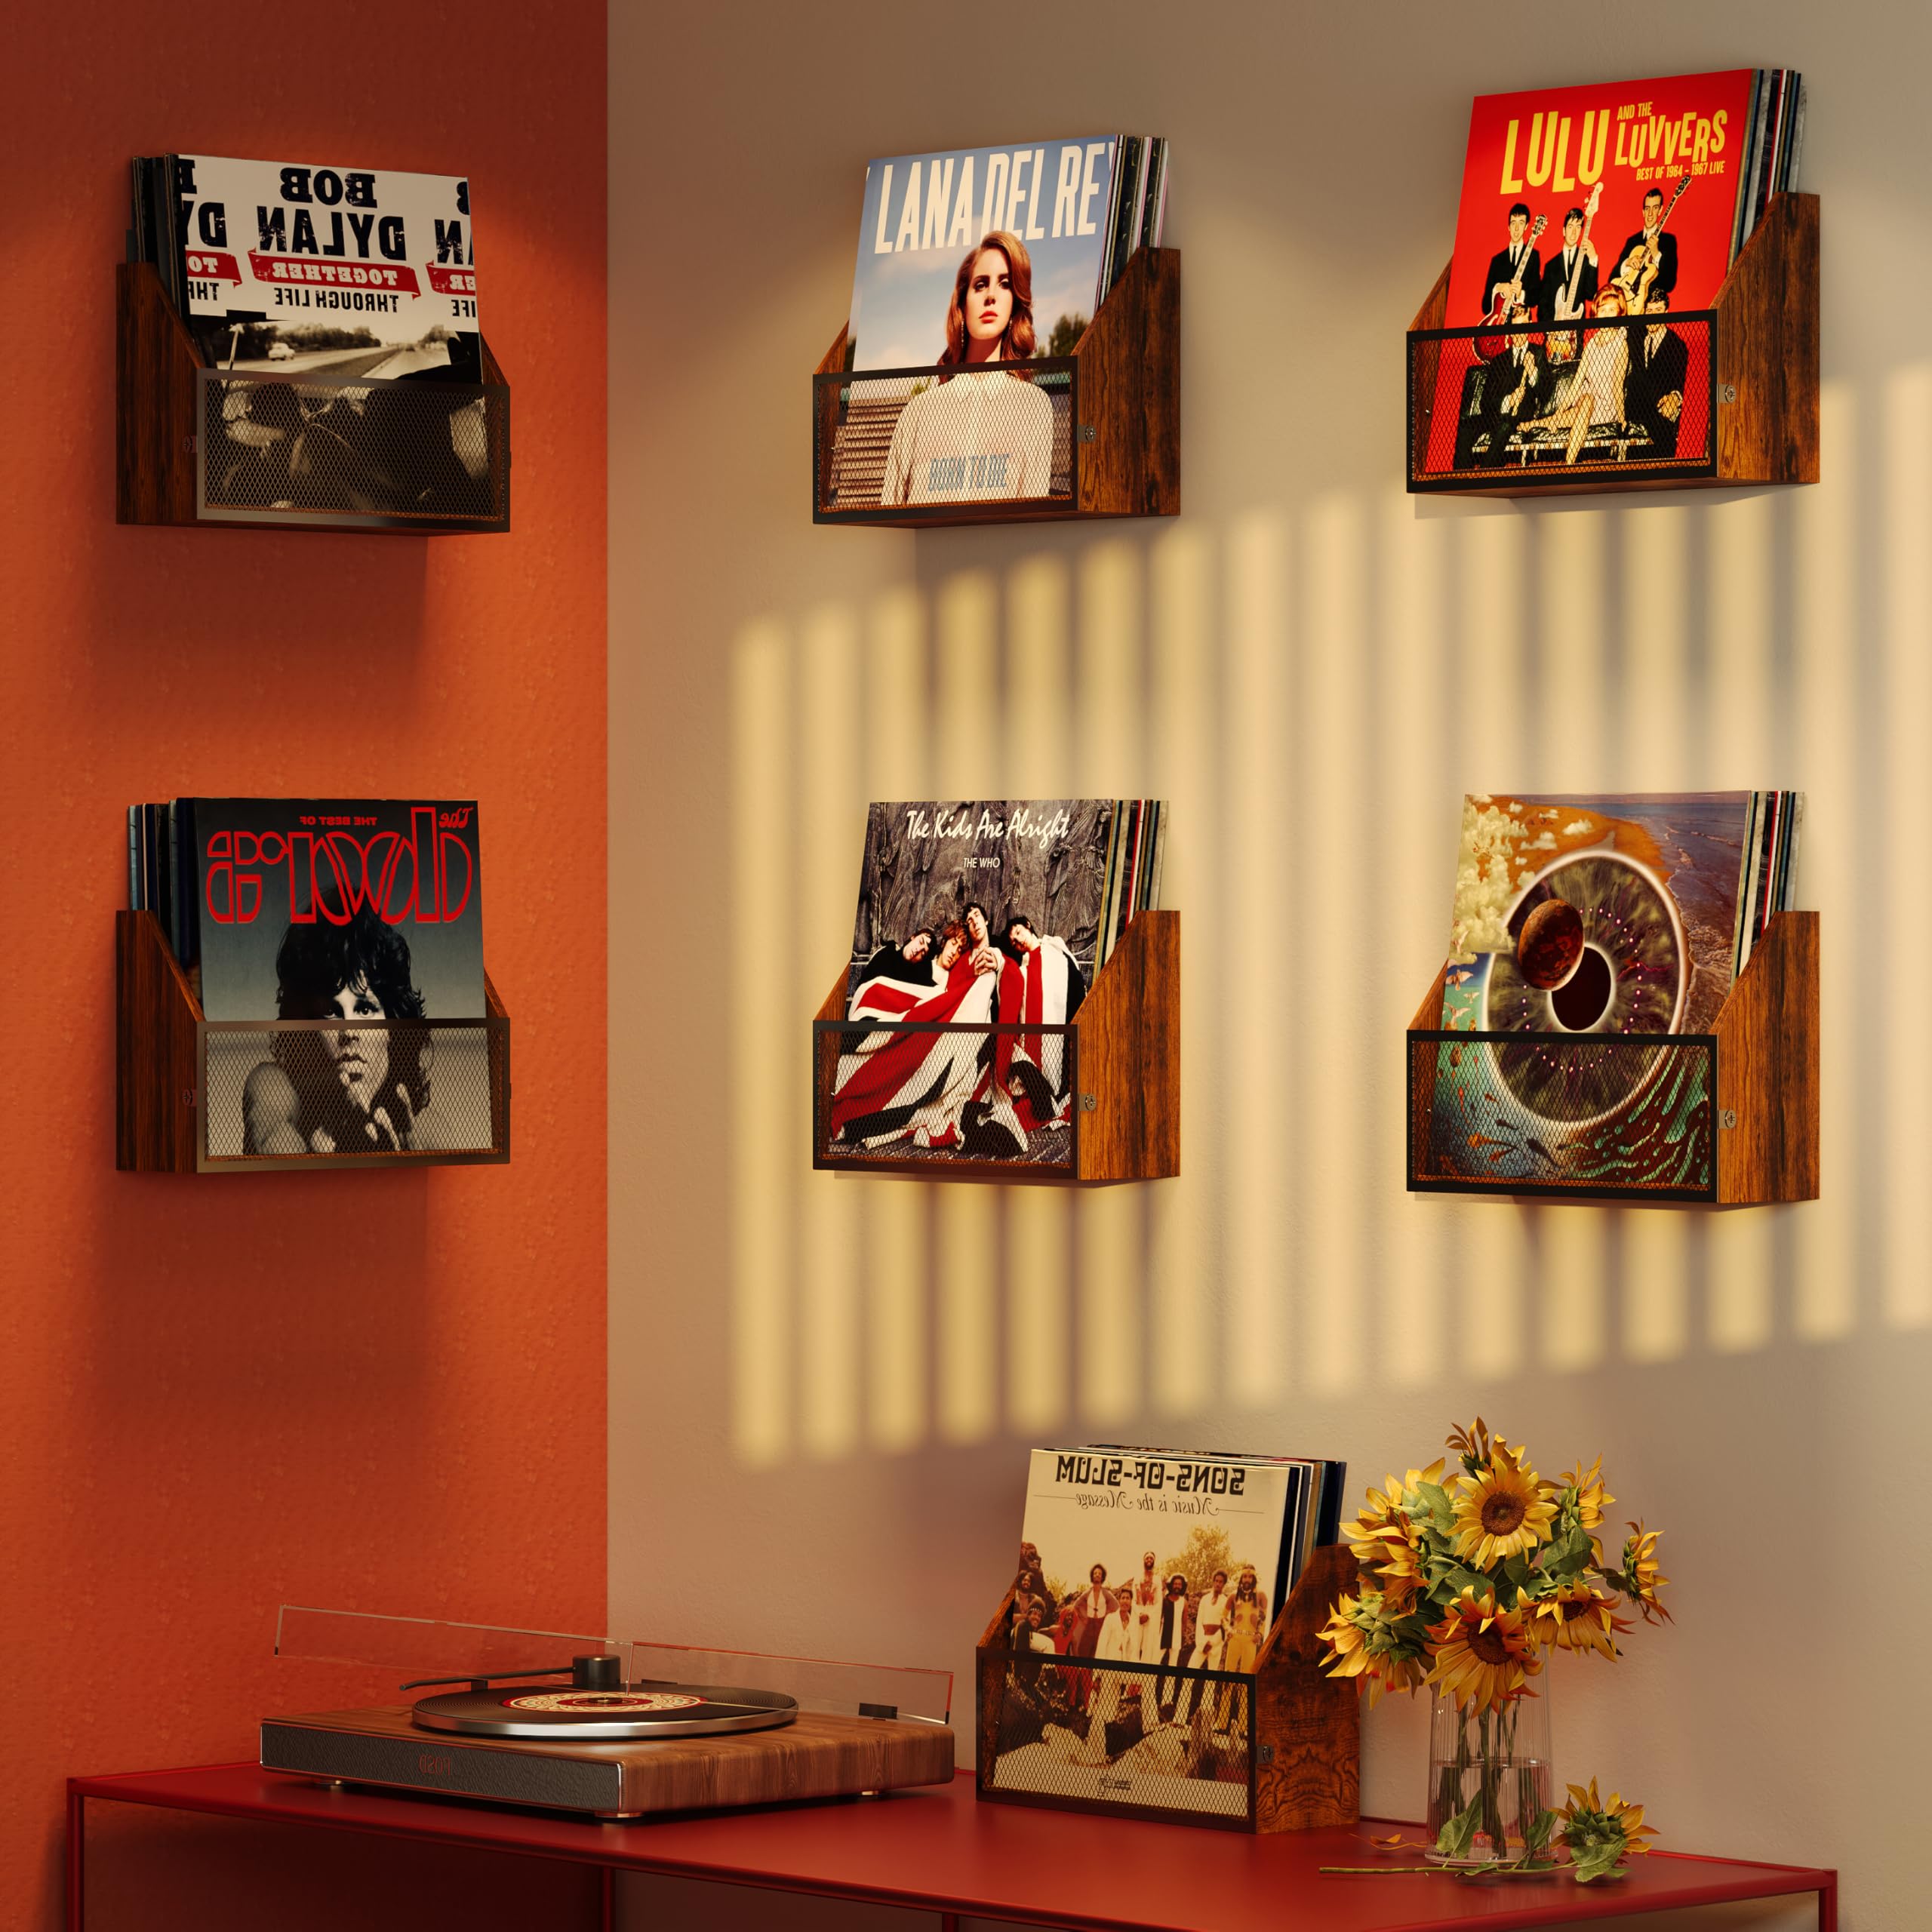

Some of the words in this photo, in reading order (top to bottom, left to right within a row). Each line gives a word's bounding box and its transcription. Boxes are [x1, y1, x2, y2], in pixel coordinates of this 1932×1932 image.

[1617, 104, 1635, 121] AND
[1638, 101, 1654, 117] THE
[1500, 109, 1611, 195] LULU
[1614, 109, 1727, 168] LUVVERS
[1635, 167, 1654, 181] BEST
[1655, 166, 1666, 179] OF
[1666, 165, 1683, 178] 1964
[1691, 162, 1708, 176] 1967
[1709, 160, 1726, 174] LIVE
[875, 155, 974, 254] LANA
[980, 149, 1044, 241] DEL
[906, 810, 929, 840] The
[934, 809, 972, 840] Kids
[975, 809, 1004, 841] Are
[1006, 808, 1069, 849] Alright
[964, 857, 977, 868] THE
[979, 857, 1001, 869] WHO
